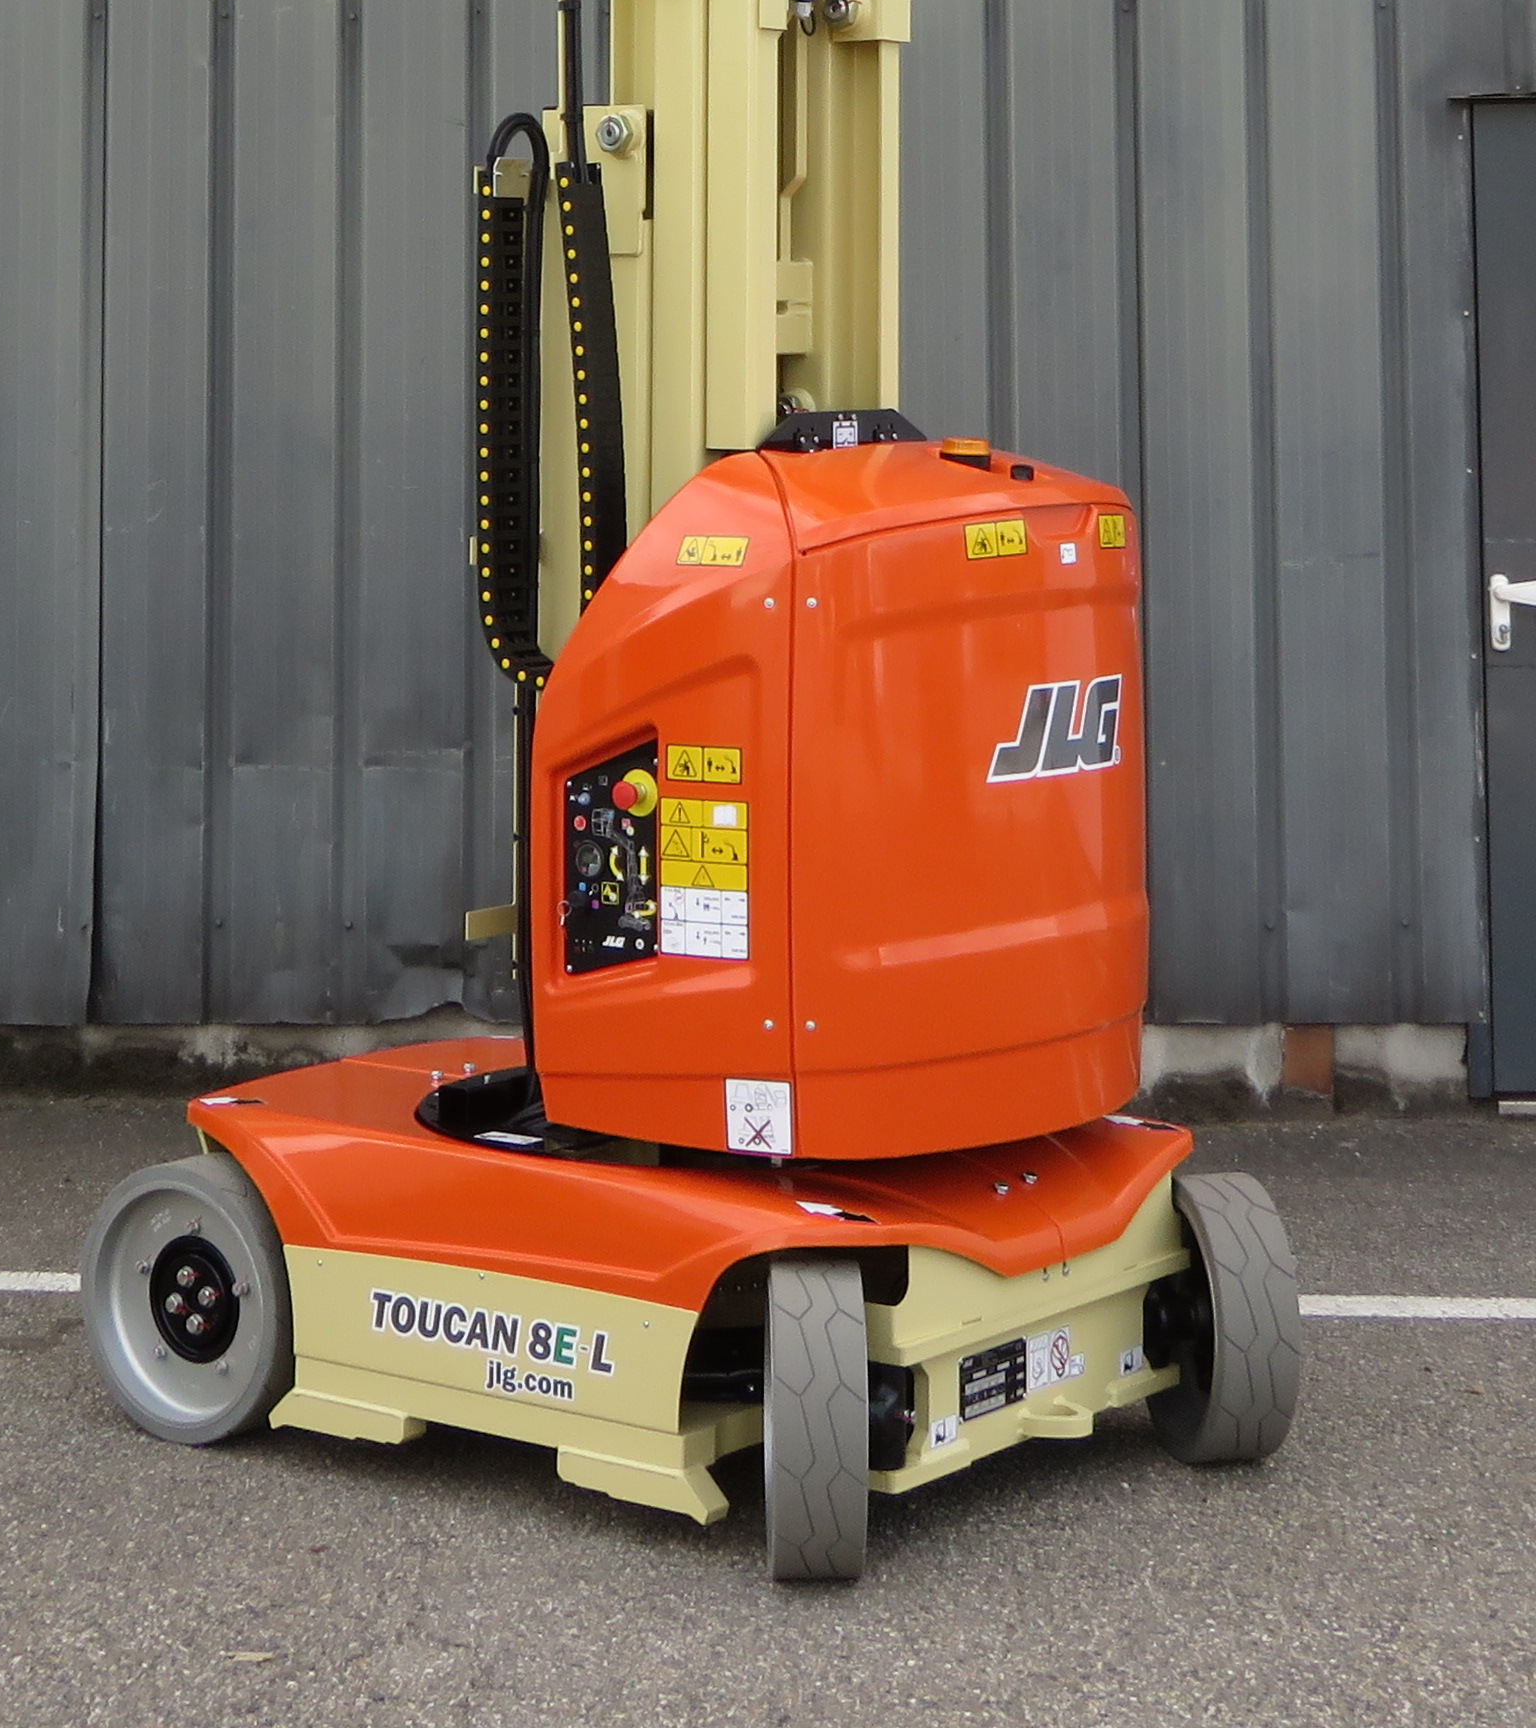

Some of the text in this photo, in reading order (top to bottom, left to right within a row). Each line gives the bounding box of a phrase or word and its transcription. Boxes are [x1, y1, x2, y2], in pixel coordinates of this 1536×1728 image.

[987, 674, 1122, 783] JLG
[371, 1290, 614, 1374] TOUCAN 8E-L
[486, 1360, 574, 1400] jlg.com
